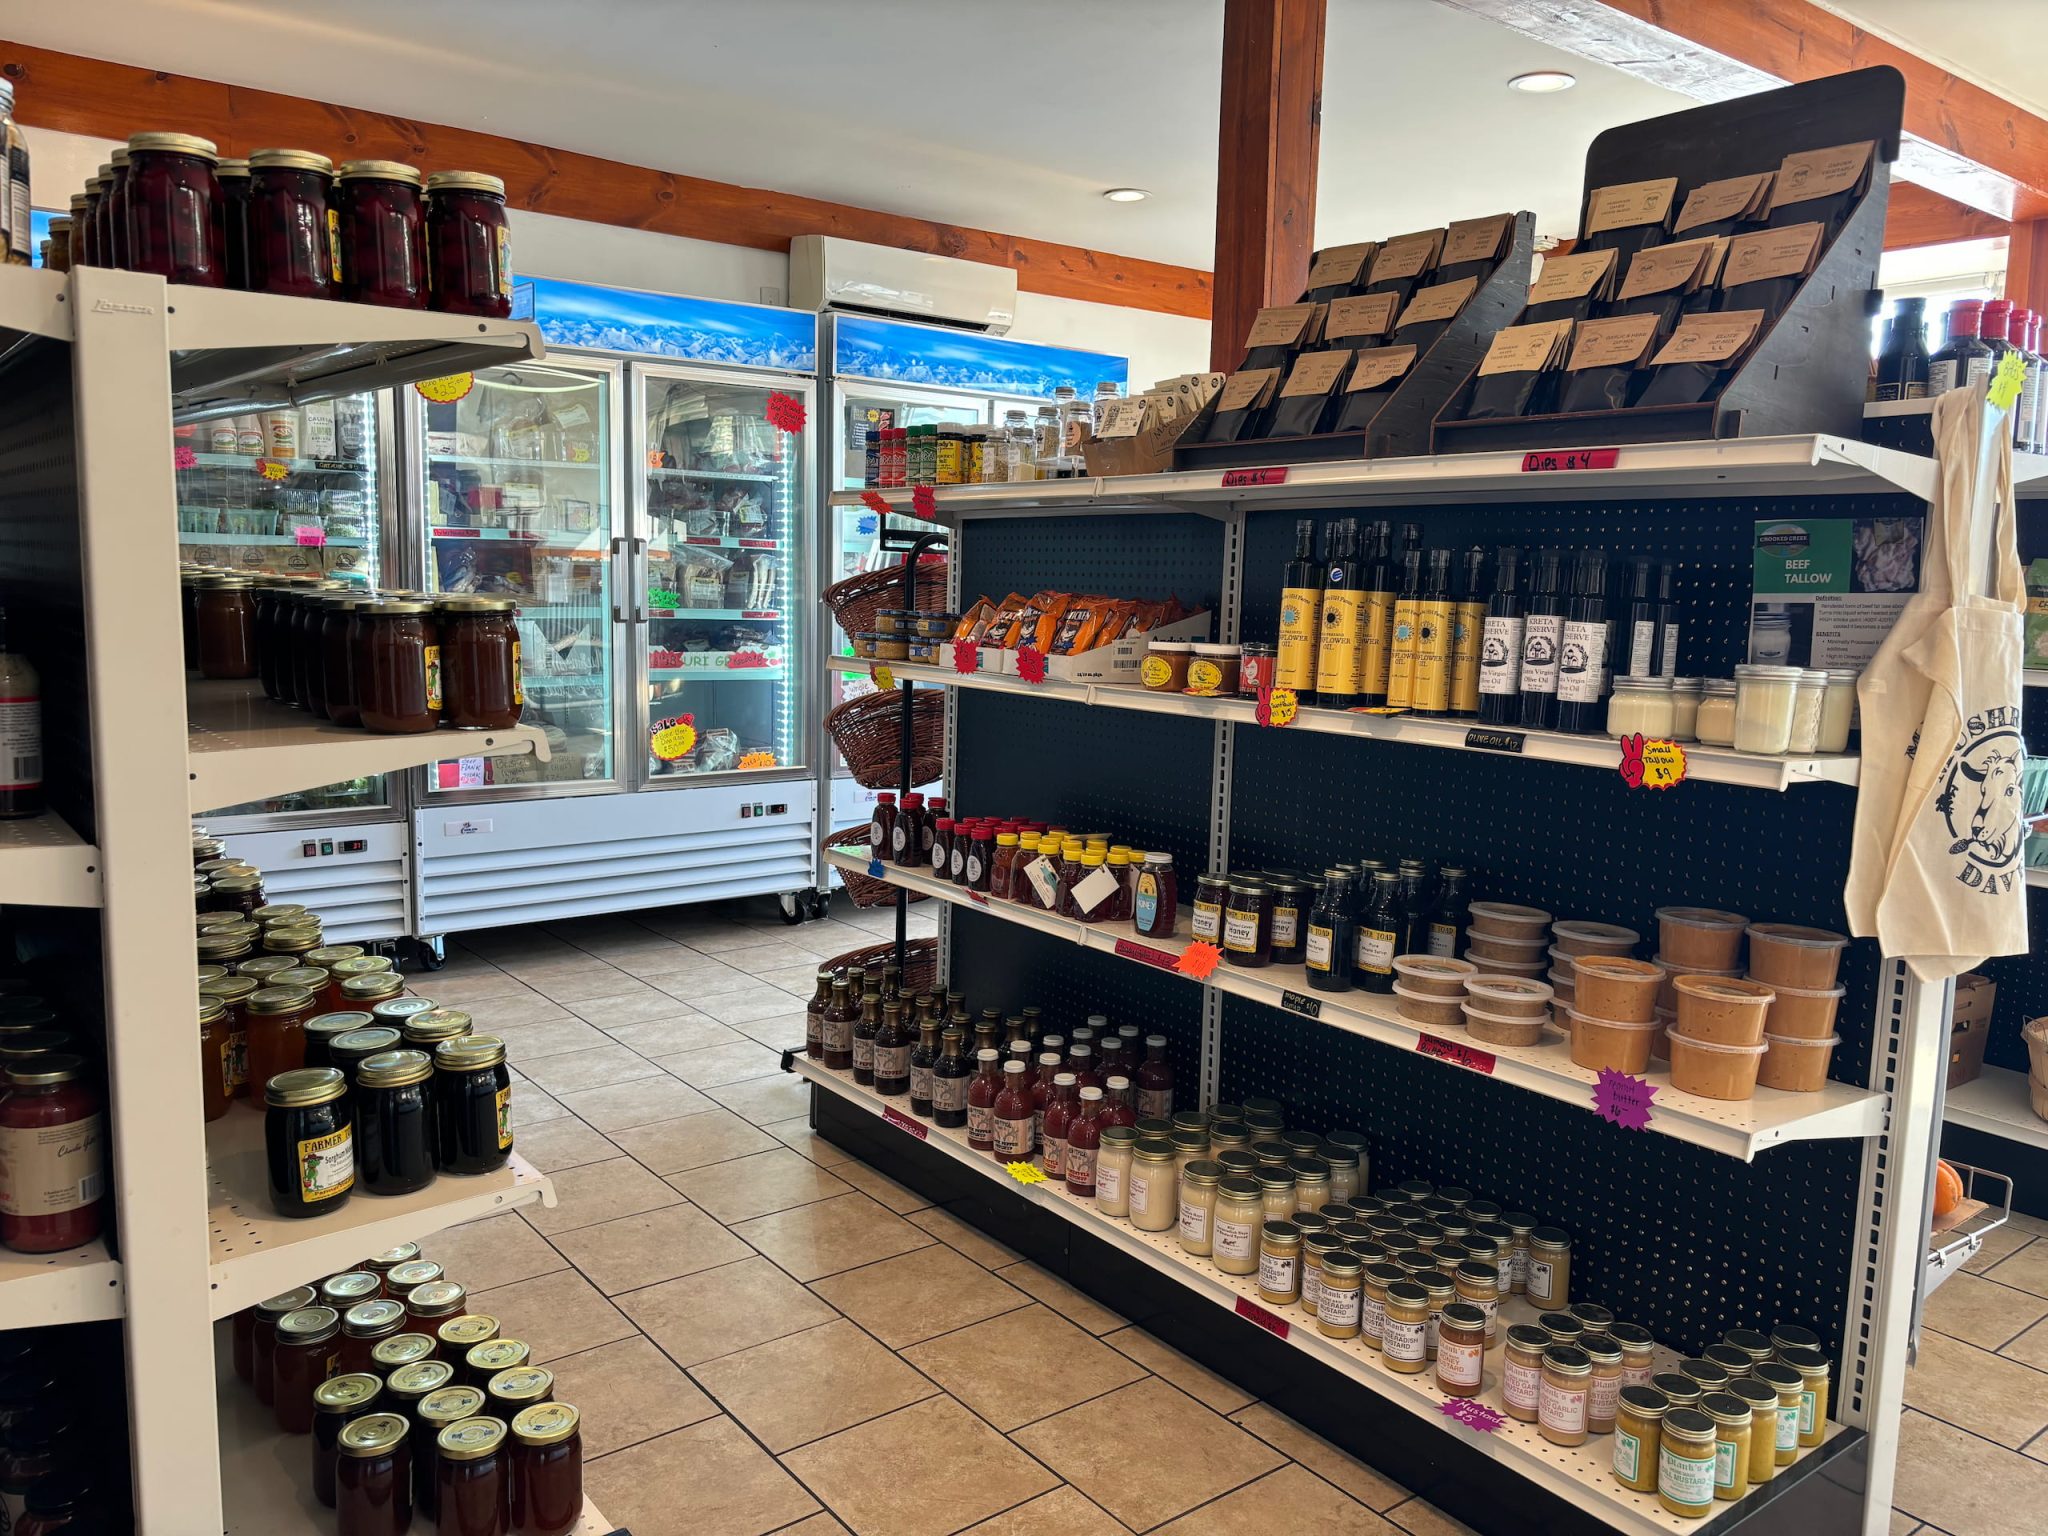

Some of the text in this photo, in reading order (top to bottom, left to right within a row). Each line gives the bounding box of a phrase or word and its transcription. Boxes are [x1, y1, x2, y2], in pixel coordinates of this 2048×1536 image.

[1785, 559, 1811, 569] BEEF
[1784, 573, 1832, 584] TALLOW
[1528, 618, 1554, 626] KRETA
[1487, 670, 1507, 679] Virgin
[1534, 669, 1554, 677] Virgin
[1565, 677, 1585, 685] Virgin
[1655, 767, 1672, 780] $9
[1204, 903, 1219, 912] TOAD
[1240, 912, 1256, 921] TOAD
[1280, 909, 1296, 917] TOAD
[1228, 927, 1250, 936] Honey
[1315, 928, 1330, 937] TOAD
[1376, 932, 1393, 941] TOAD
[305, 1133, 342, 1152] FARMER
[325, 1150, 346, 1164] Sorghum
[1456, 1401, 1501, 1424] Mustard
[1552, 1402, 1578, 1414] GARLIC
[1456, 1410, 1477, 1422] $5
[1673, 1474, 1707, 1485] MUSTARD
